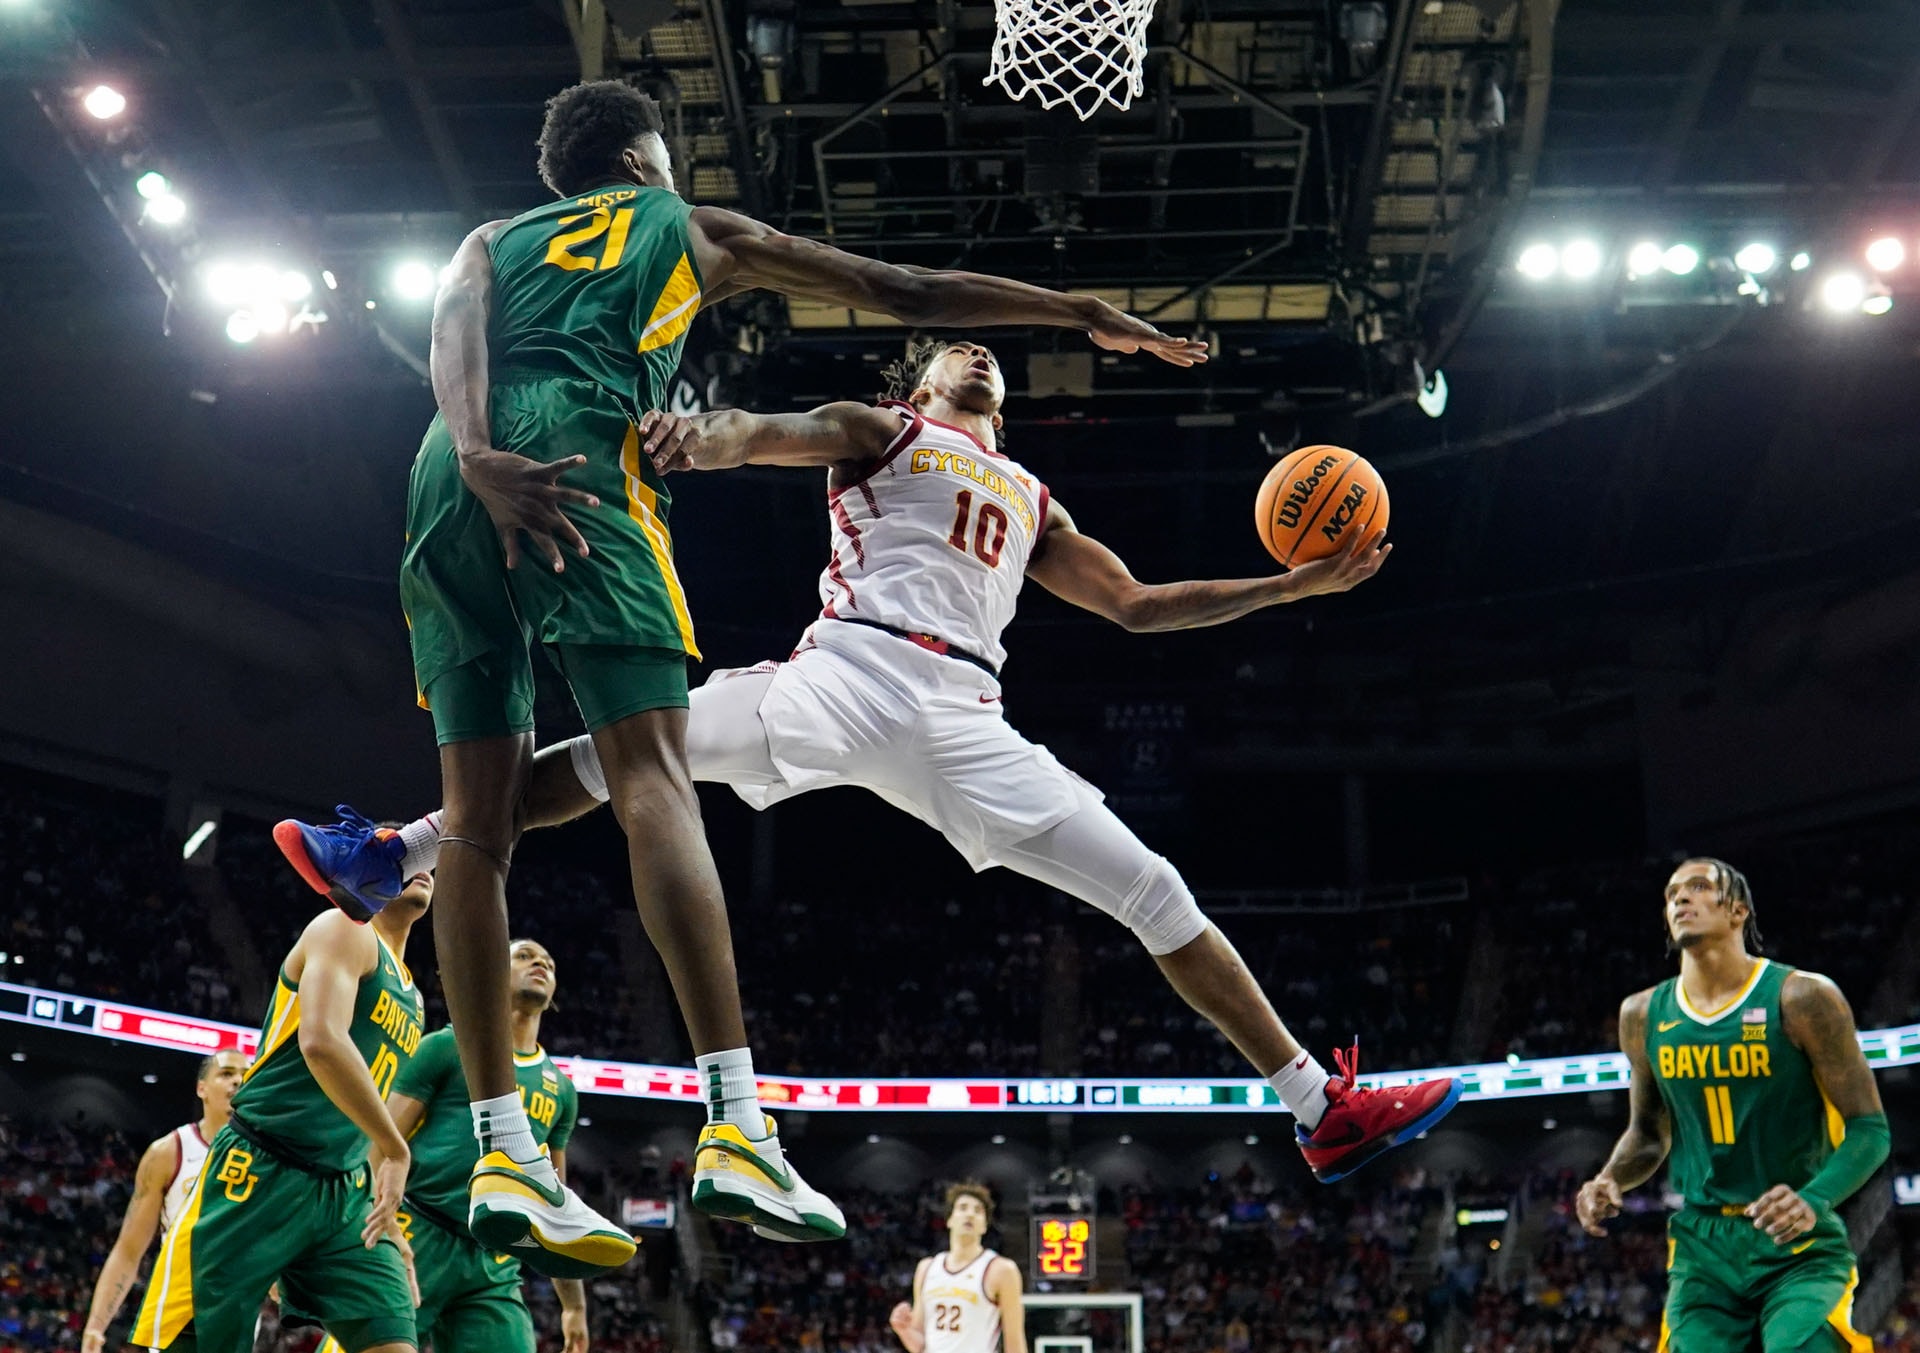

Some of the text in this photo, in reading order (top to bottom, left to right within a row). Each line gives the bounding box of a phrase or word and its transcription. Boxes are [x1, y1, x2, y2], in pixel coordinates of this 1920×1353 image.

[544, 206, 635, 272] 21
[1277, 455, 1339, 529] Wilson
[1320, 482, 1368, 543] NCAA
[948, 489, 1010, 569] 10
[369, 1042, 398, 1104] 10
[1658, 1043, 1771, 1079] BAYLOR
[516, 1083, 557, 1128] LOR
[1703, 1085, 1735, 1145] 11
[1041, 1240, 1084, 1274] 22
[935, 1304, 961, 1332] 22
